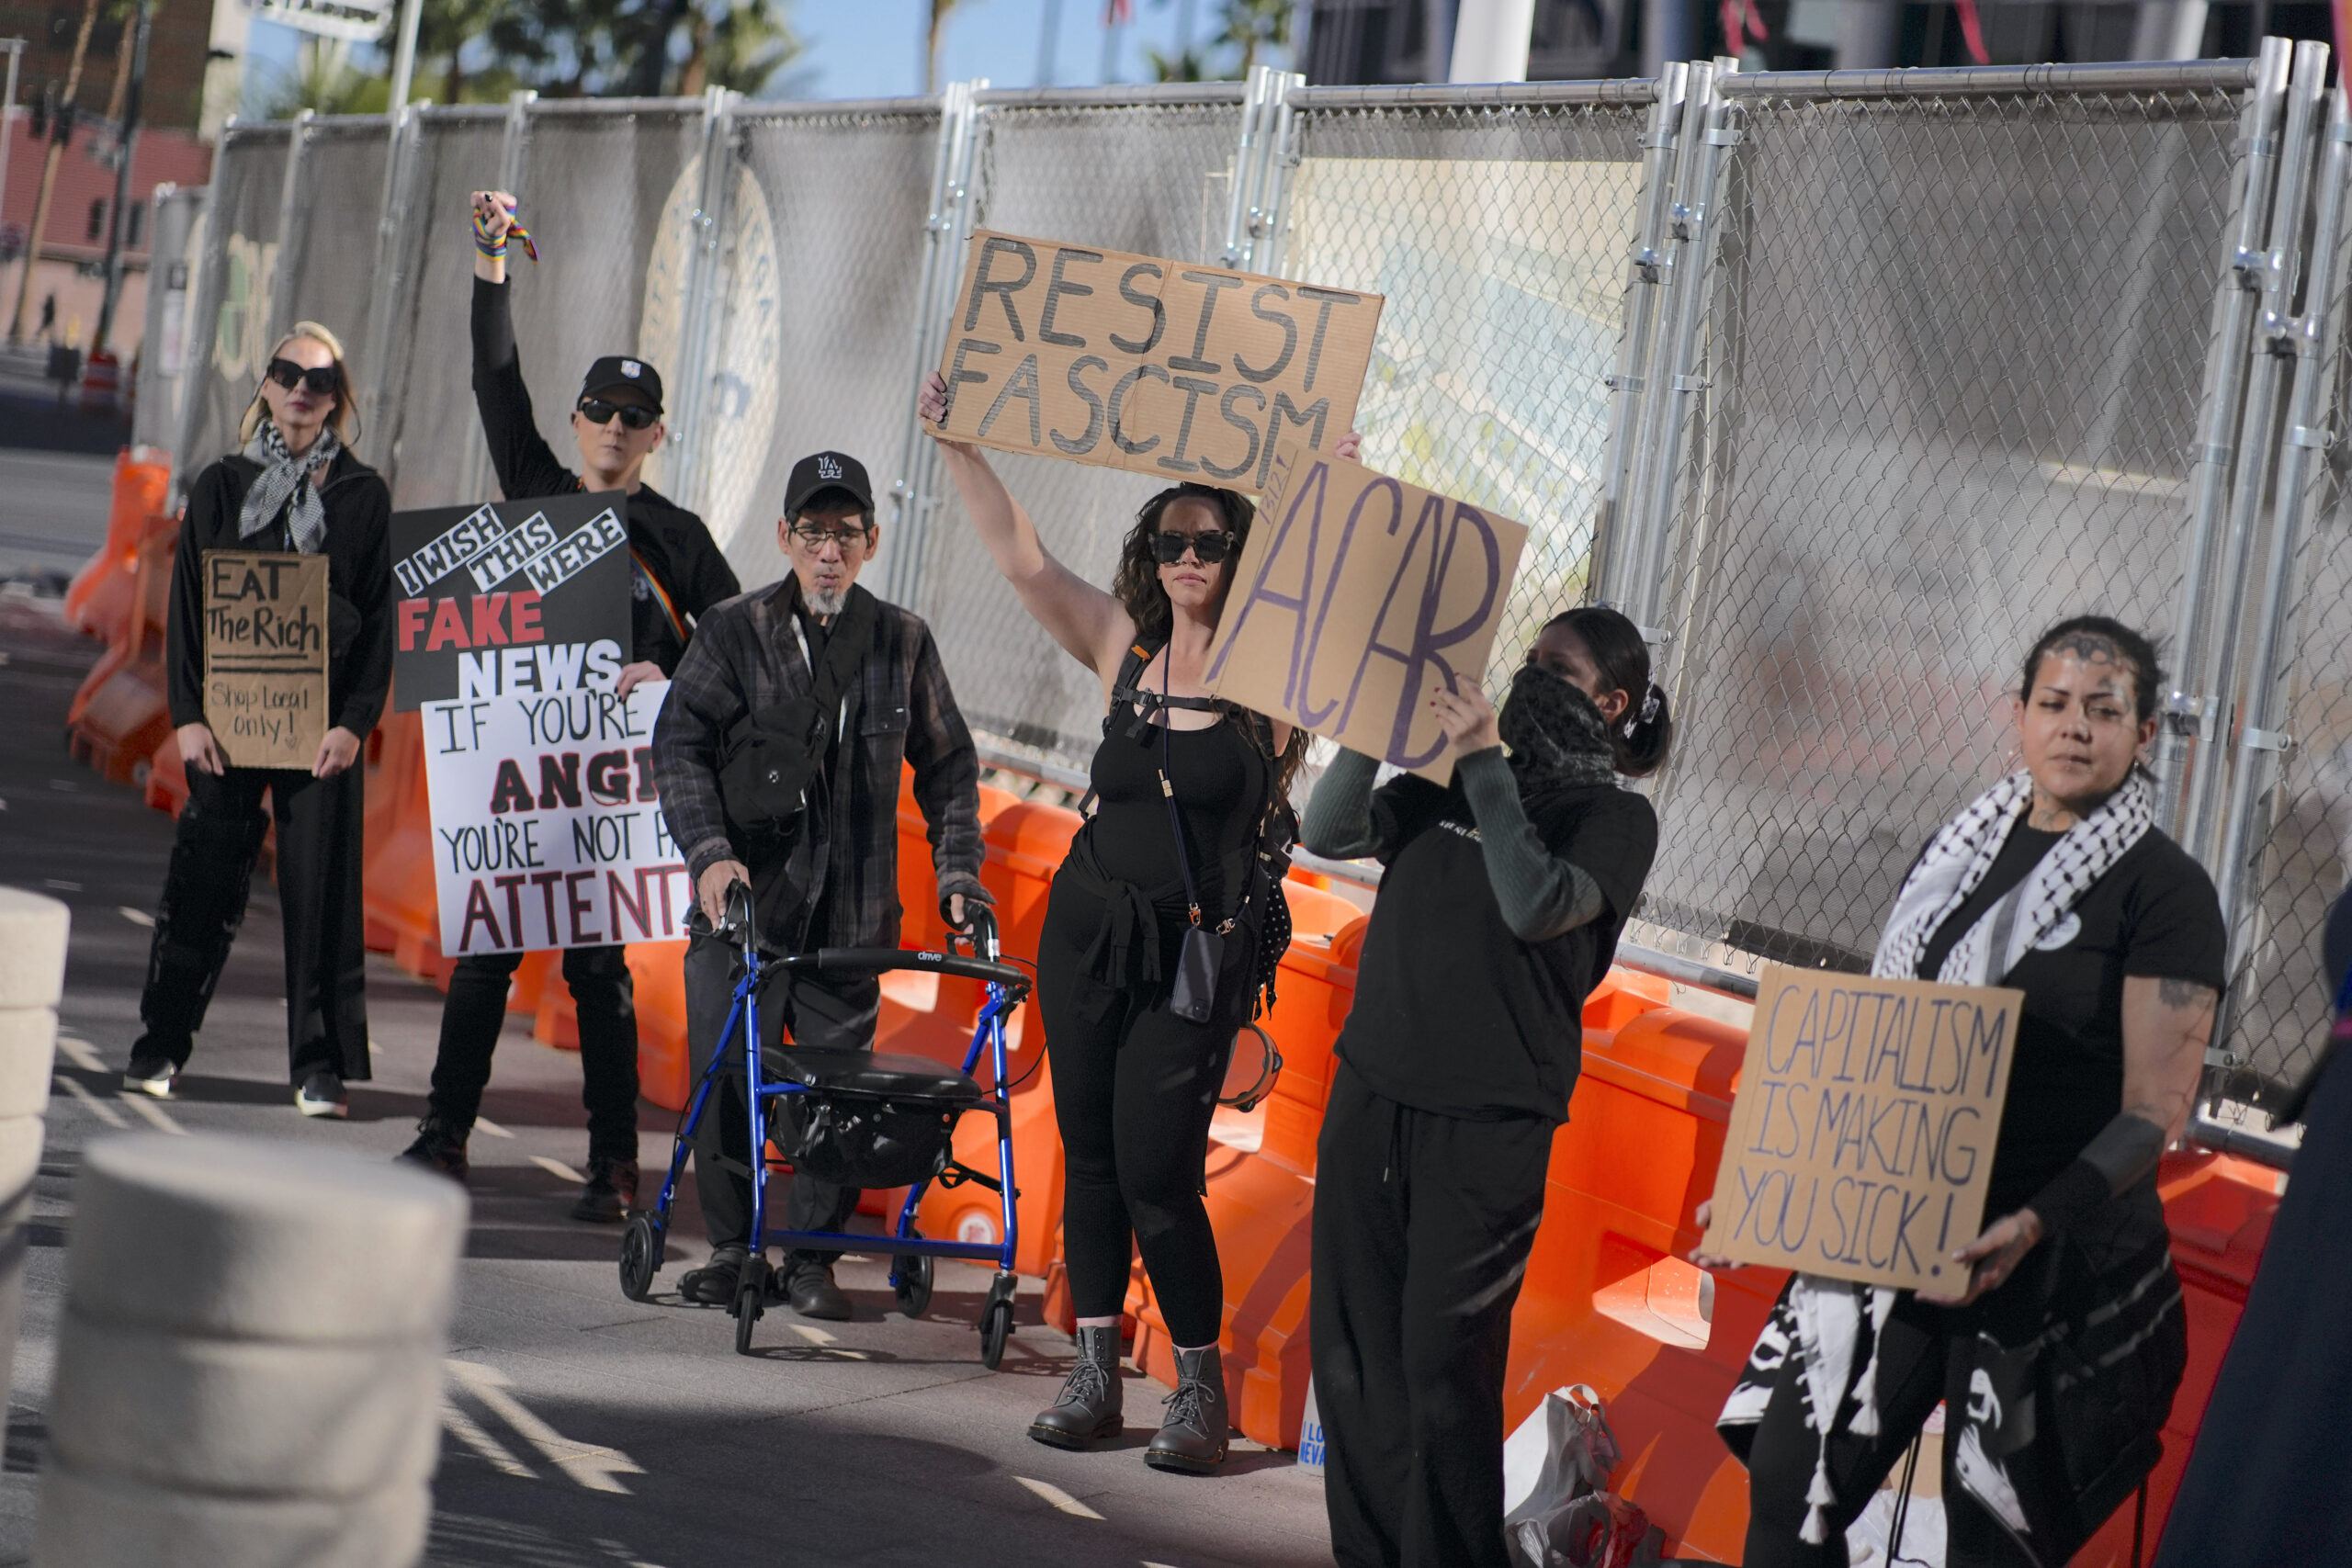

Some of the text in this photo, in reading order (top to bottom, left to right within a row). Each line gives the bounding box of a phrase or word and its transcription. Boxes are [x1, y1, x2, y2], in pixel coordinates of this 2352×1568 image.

[964, 237, 1362, 393] RESIST
[937, 338, 1330, 490] FASCISM
[1259, 454, 1290, 525] 1312!
[212, 558, 300, 602] EAT
[398, 507, 503, 593] I WISH
[471, 516, 553, 584] THIS
[526, 513, 623, 592] WERE
[207, 605, 320, 651] The Rich
[398, 590, 545, 651] FAKE
[1204, 462, 1501, 769] ACAB
[211, 682, 257, 713] Shop
[458, 639, 622, 698] NEWS
[435, 689, 646, 753] IF YOU'RE
[440, 818, 544, 874] YOU'RE
[572, 813, 641, 863] NOT
[459, 864, 691, 952] ATTENT
[918, 951, 942, 962] drive
[1768, 986, 2006, 1098] CAPITALISM
[1748, 1080, 1981, 1186] IS MAKING
[1734, 1167, 1954, 1277] YOU SICK!
